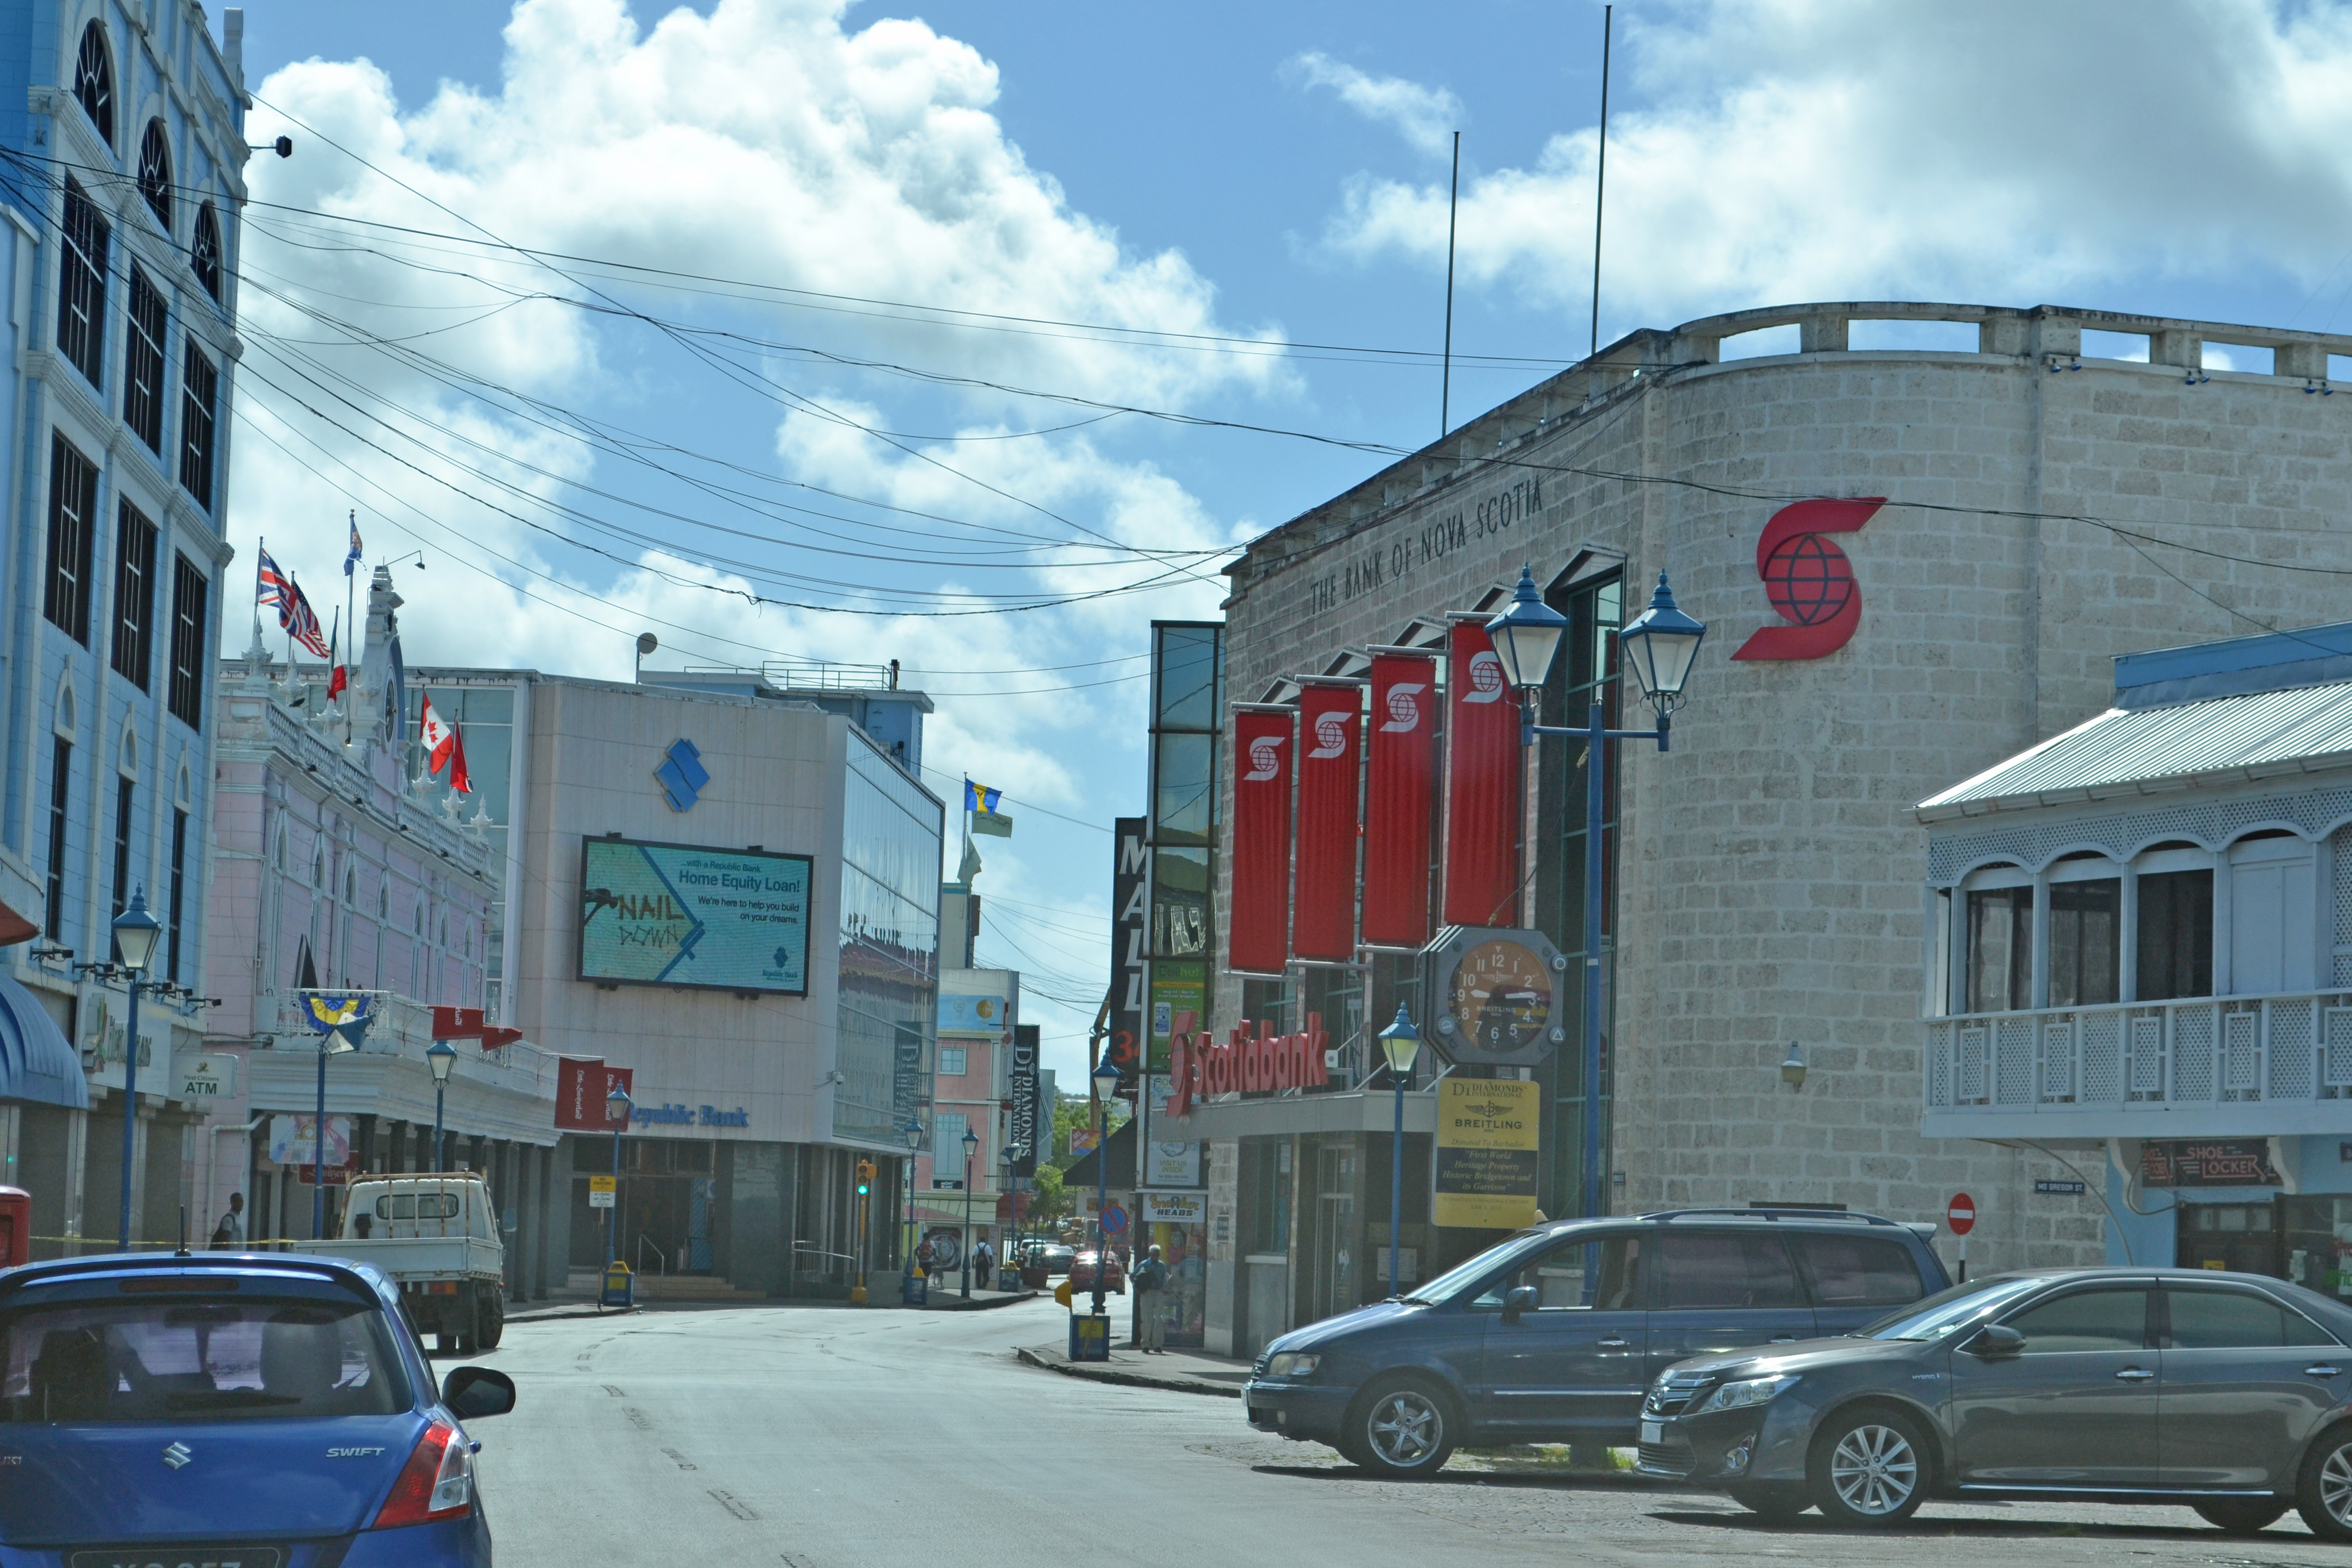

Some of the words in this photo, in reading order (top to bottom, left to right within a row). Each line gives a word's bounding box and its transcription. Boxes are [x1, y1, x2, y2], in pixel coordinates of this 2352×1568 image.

[1310, 574, 1337, 615] THE
[1345, 551, 1383, 600] BANK
[1392, 537, 1412, 576] OF
[1421, 512, 1465, 565] NOVA
[1477, 474, 1543, 539] SCOTIA
[710, 862, 740, 871] Republic
[743, 864, 761, 872] Bank
[679, 869, 718, 886] Home
[722, 873, 762, 892] Equity
[766, 877, 800, 892] Loan!
[618, 894, 684, 920] NAIL
[698, 896, 719, 905] We're
[721, 898, 738, 906] here
[749, 900, 764, 911] help
[766, 903, 780, 912] you
[781, 903, 799, 912] build
[751, 914, 768, 923] your
[769, 914, 798, 924] dreams.
[1118, 836, 1145, 1011] MALL
[618, 924, 678, 948] DOWN
[1477, 959, 1485, 972] 11
[1491, 954, 1505, 967] 12
[1513, 960, 1518, 973] 1
[1463, 973, 1476, 987] 10
[1524, 975, 1532, 988] 2
[1457, 989, 1466, 1002] 9
[1528, 994, 1537, 1006] 3
[1461, 1007, 1469, 1020] 8
[1476, 1005, 1516, 1013] BREITLING
[1522, 1010, 1532, 1023] 4
[1474, 1020, 1483, 1034] 7
[1490, 1026, 1499, 1040] 6
[1509, 1023, 1518, 1036] 5
[1114, 1031, 1140, 1063] 3
[1193, 1012, 1329, 1095] Scotiabank
[185, 1082, 217, 1095] ATM
[1472, 1083, 1523, 1093] DIAMONDS
[1012, 1076, 1021, 1143] INTERNATION
[700, 1105, 749, 1128] Bank
[1021, 1077, 1033, 1157] DIAMONDS
[1455, 1119, 1522, 1129] BREITLING
[1493, 1140, 1525, 1148] Barbados
[1489, 1151, 1512, 1159] World
[2187, 1146, 2224, 1159] SHOE
[1455, 1160, 1487, 1170] Heritage
[1488, 1162, 1521, 1172] Property
[2202, 1160, 2262, 1180] LOCKER
[1442, 1170, 1473, 1179] Historic
[1474, 1172, 1516, 1181] Bridgetown
[2048, 1183, 2074, 1191] GREGOR
[326, 1447, 385, 1458] SWIFT
